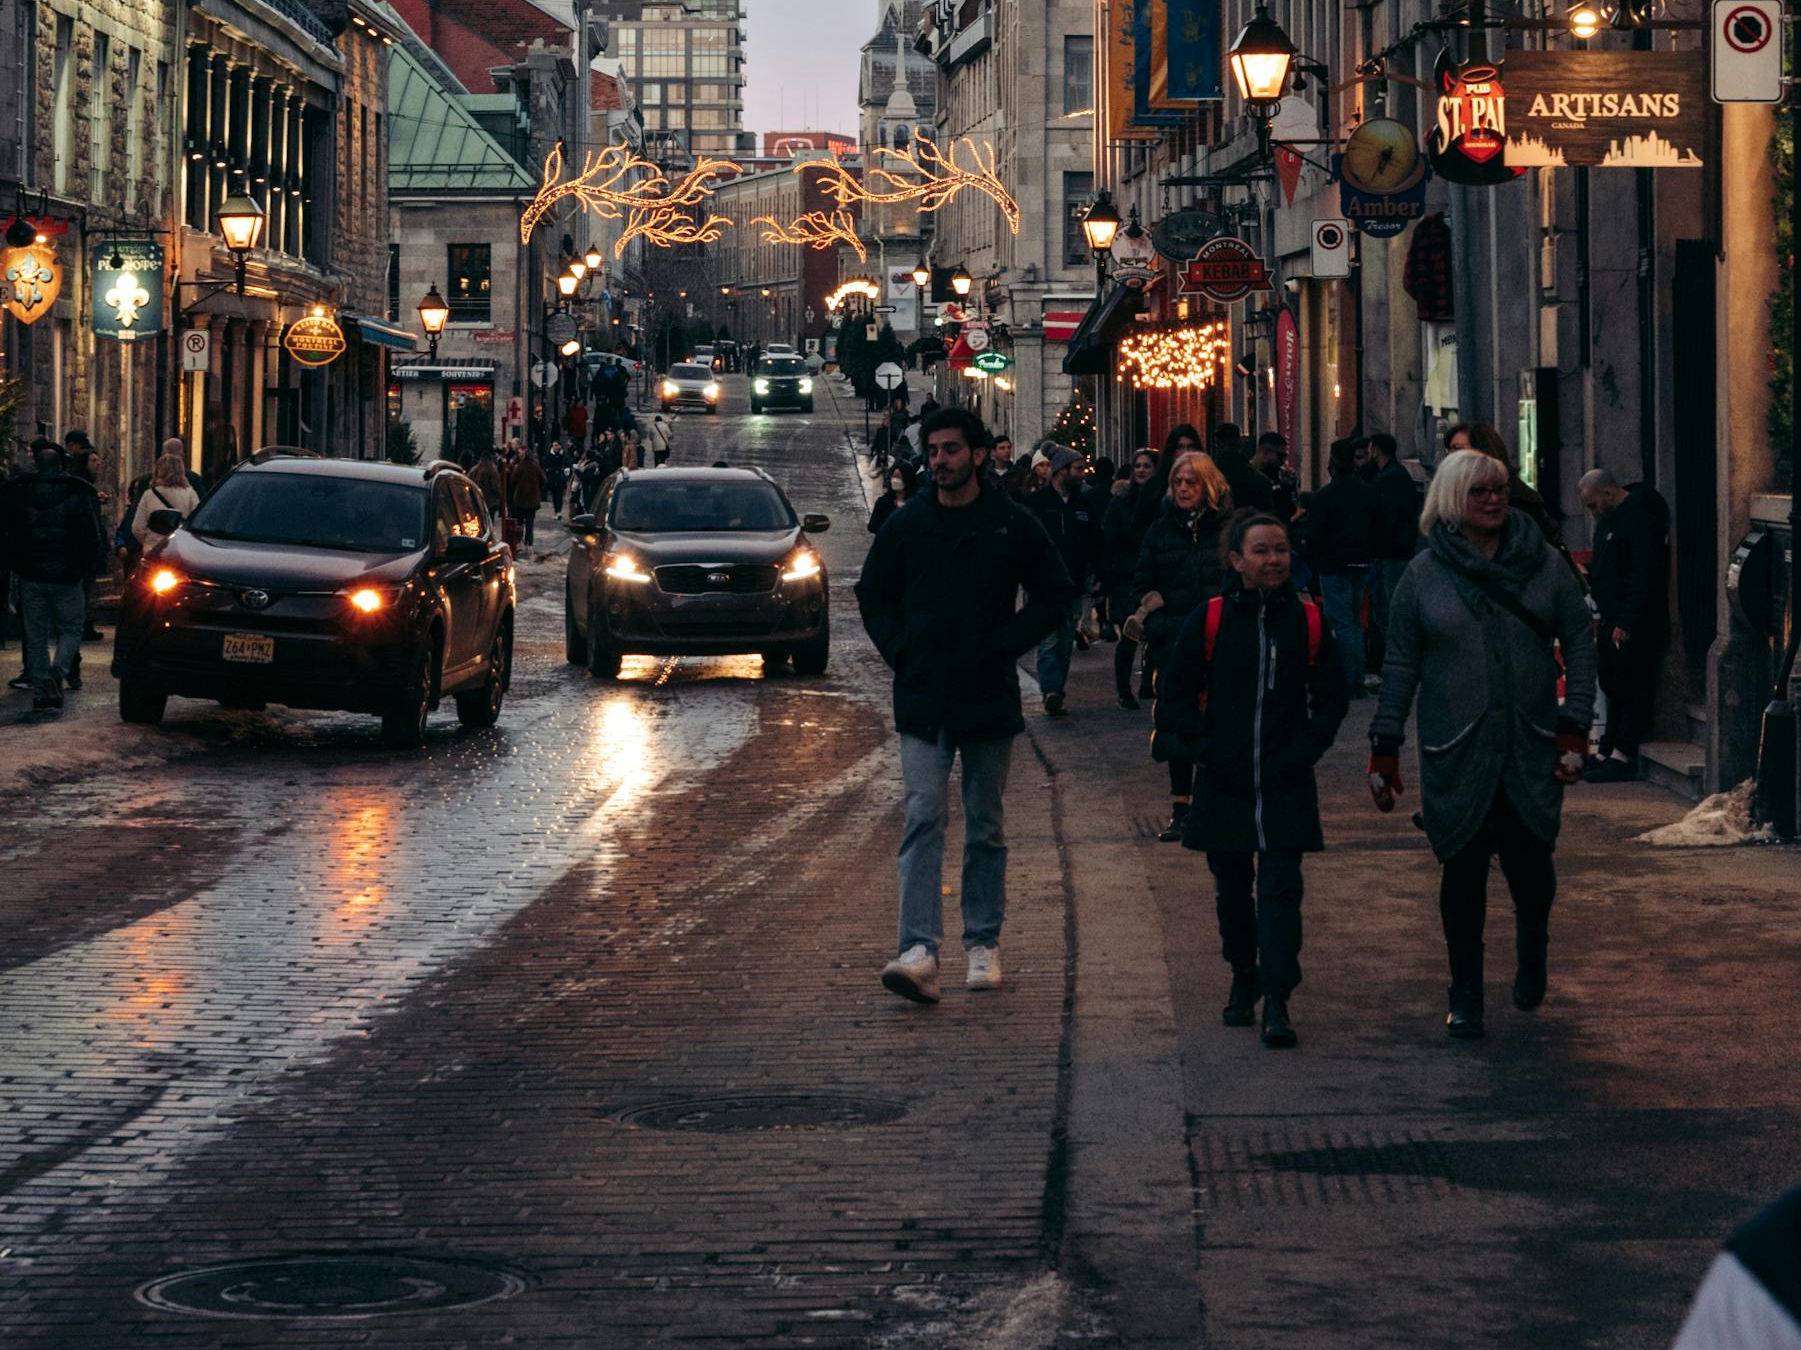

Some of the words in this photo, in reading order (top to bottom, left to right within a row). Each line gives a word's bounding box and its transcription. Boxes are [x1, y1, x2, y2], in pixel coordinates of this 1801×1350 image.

[1465, 83, 1491, 95] PUB
[1528, 93, 1680, 121] ARTISANS
[1437, 96, 1465, 155] ST.
[1471, 97, 1505, 137] PA
[1347, 195, 1420, 217] Amber
[1202, 241, 1249, 259] MONTREAL
[1203, 263, 1250, 280] KEBAB
[391, 370, 419, 378] ARTIER
